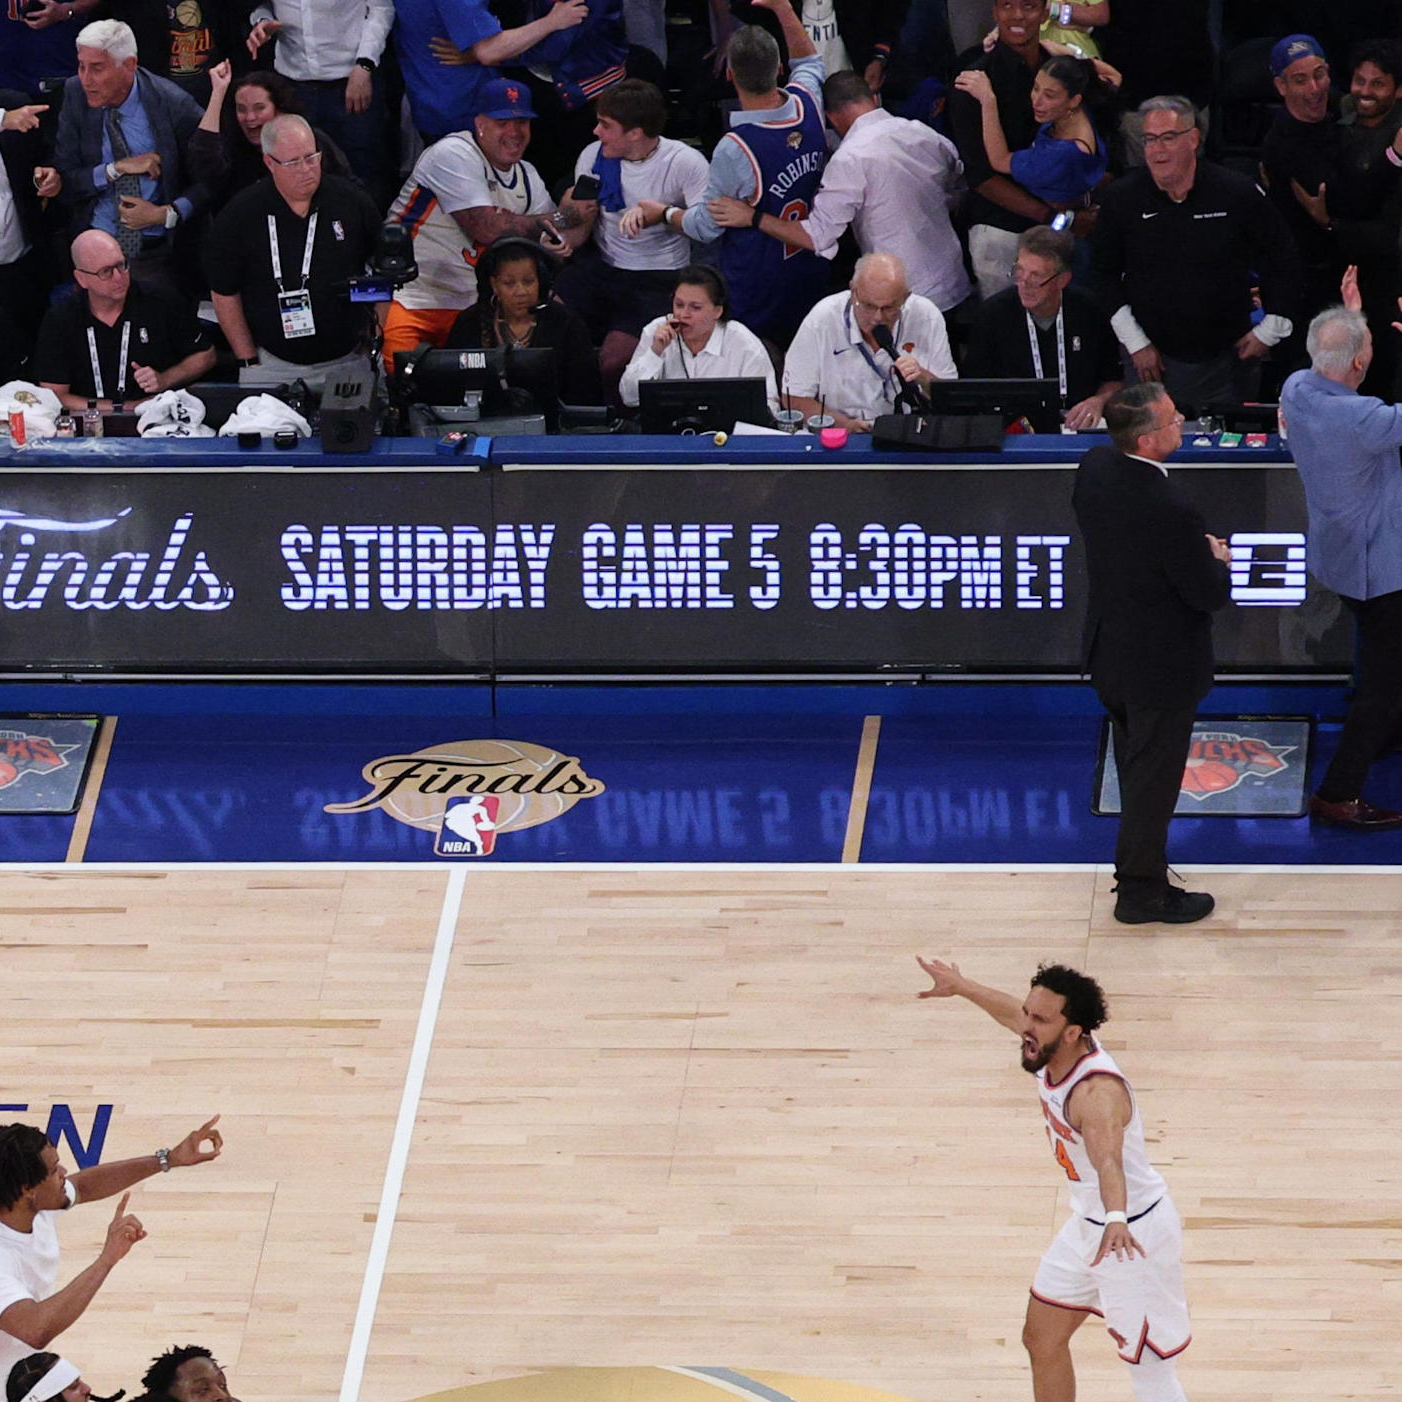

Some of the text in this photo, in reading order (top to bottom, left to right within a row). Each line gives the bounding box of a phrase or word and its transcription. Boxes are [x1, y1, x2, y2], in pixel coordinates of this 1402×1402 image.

[769, 151, 823, 199] ROBINS
[468, 352, 487, 369] NBA
[281, 523, 1071, 610] SATURDAY GAME 5 8:30PM ET
[1190, 740, 1283, 772] ICKS
[344, 757, 596, 811] Finals
[443, 841, 472, 853] NBA
